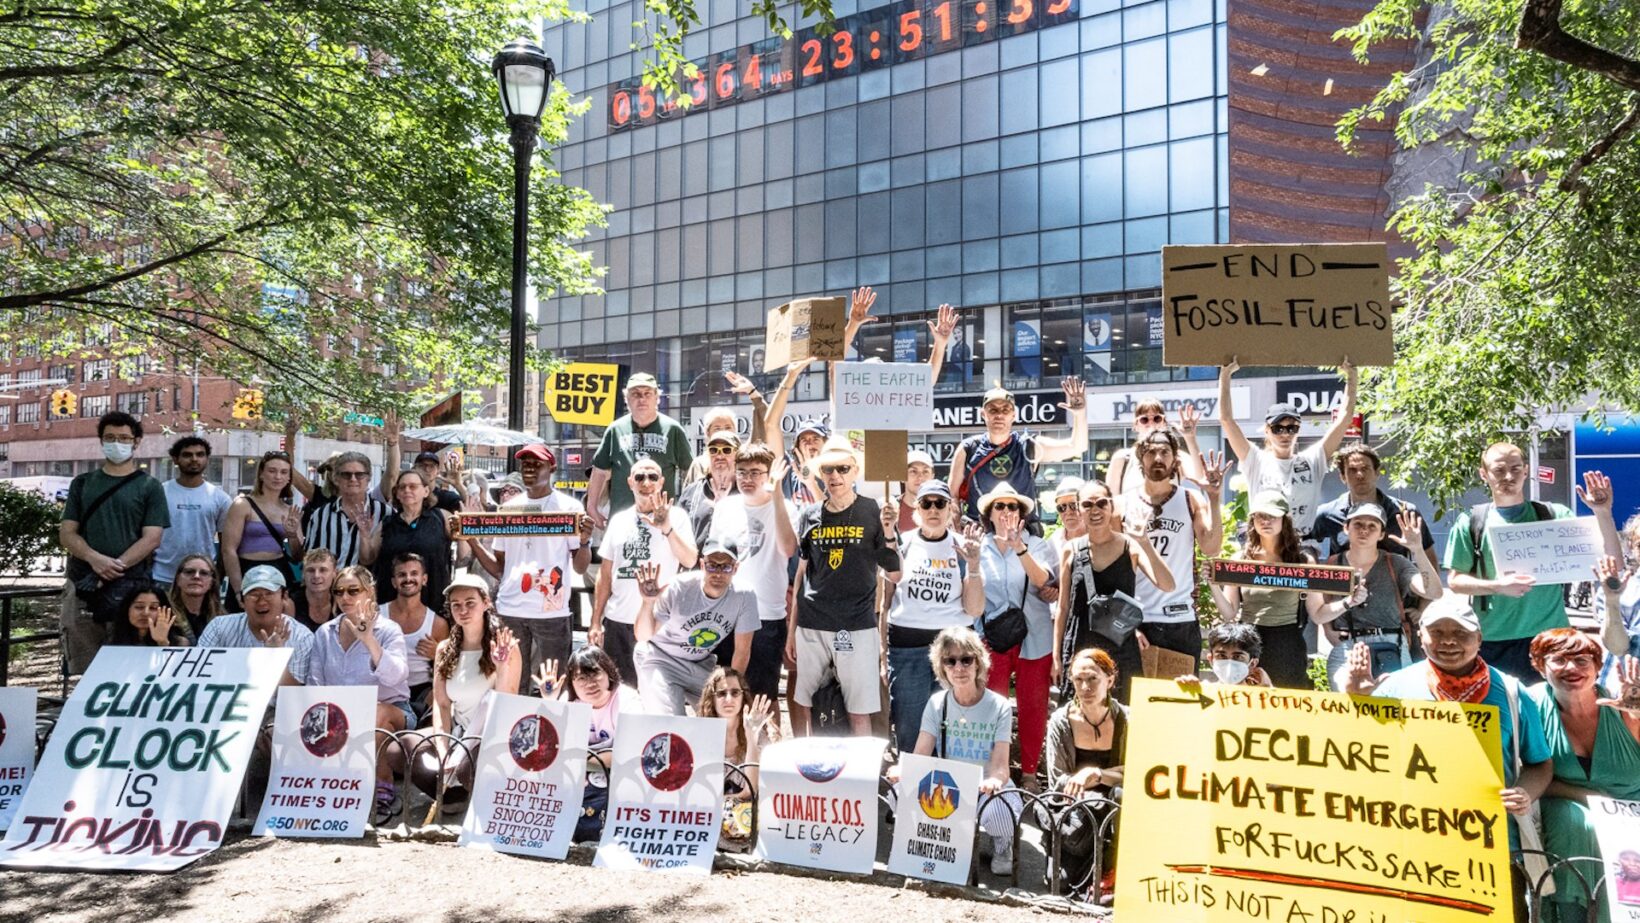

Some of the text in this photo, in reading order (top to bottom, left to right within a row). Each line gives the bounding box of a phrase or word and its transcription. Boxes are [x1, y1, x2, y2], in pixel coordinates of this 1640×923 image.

[1223, 253, 1316, 278] END
[1170, 294, 1387, 337] FOSSIL FUELS
[555, 373, 614, 393] BEST
[841, 372, 925, 386] THE EARTH
[556, 394, 607, 415] BUY
[844, 392, 929, 407] IS ON FIRE!
[480, 515, 503, 525] Youth
[506, 515, 525, 524] Feel
[527, 515, 574, 525] EcoAnxiety
[812, 526, 864, 539] SUNRISE
[1498, 529, 1543, 543] DESTROY
[1150, 536, 1169, 556] 72
[1506, 547, 1536, 560] SAVE
[1554, 544, 1594, 554] PLANET
[1216, 563, 1350, 580] 5 YEARS 365 DAYS 23:51:38
[1253, 576, 1308, 588] ACTINTIME
[908, 586, 949, 603] NOW
[681, 612, 712, 631] THERE
[714, 613, 724, 623] IS
[159, 648, 226, 678] THE
[1218, 689, 1257, 710] HEY
[1260, 689, 1319, 715] POTUS,
[1321, 699, 1350, 714] CAN
[1353, 700, 1381, 719] YOU
[64, 727, 240, 773] CLOCK
[1216, 727, 1439, 784] DECLARE A
[280, 776, 362, 791] TICK TOCK
[504, 777, 557, 797] DON'T
[270, 794, 361, 810] TIME'S UP!
[492, 791, 563, 814] HIT THE
[773, 793, 865, 827] CLIMATE S.O.S.
[1601, 800, 1640, 817] URG
[266, 816, 349, 832] 350NYC.ORG
[492, 807, 557, 828] SNOOZE
[616, 807, 713, 826] IT'S TIME!
[1325, 792, 1499, 849] EMERGENCY
[485, 821, 555, 842] BUTTON
[613, 826, 709, 842] FIGHT FOR
[785, 823, 865, 844] LEGACY
[917, 822, 952, 842] CHASE-ING
[907, 840, 957, 864] CLIMATE CHAOS
[1226, 888, 1281, 920] NOT
[1287, 899, 1314, 922] A
